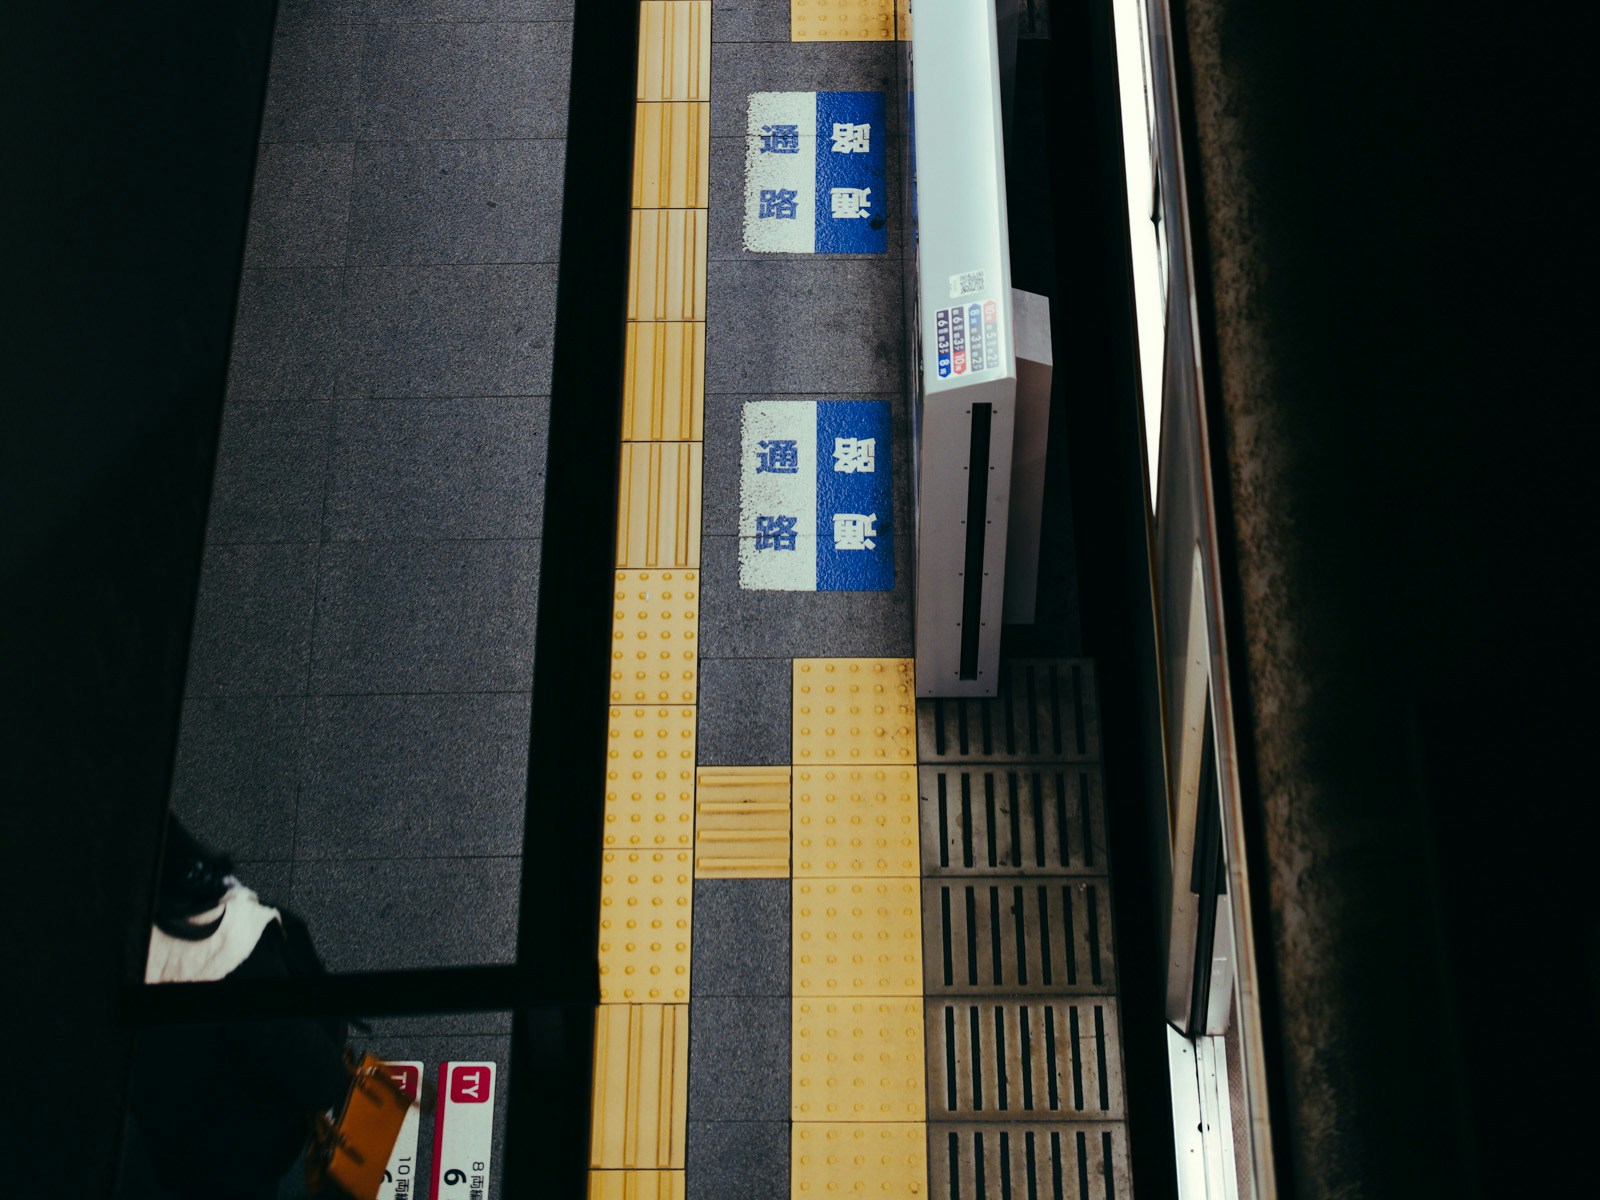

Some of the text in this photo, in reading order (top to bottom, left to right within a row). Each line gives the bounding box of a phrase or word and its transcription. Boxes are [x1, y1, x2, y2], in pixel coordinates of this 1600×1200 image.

[758, 124, 799, 219] 通路
[830, 122, 872, 219] 通路
[755, 440, 799, 550] 通路
[833, 438, 877, 550] 通路
[461, 1071, 480, 1099] TY
